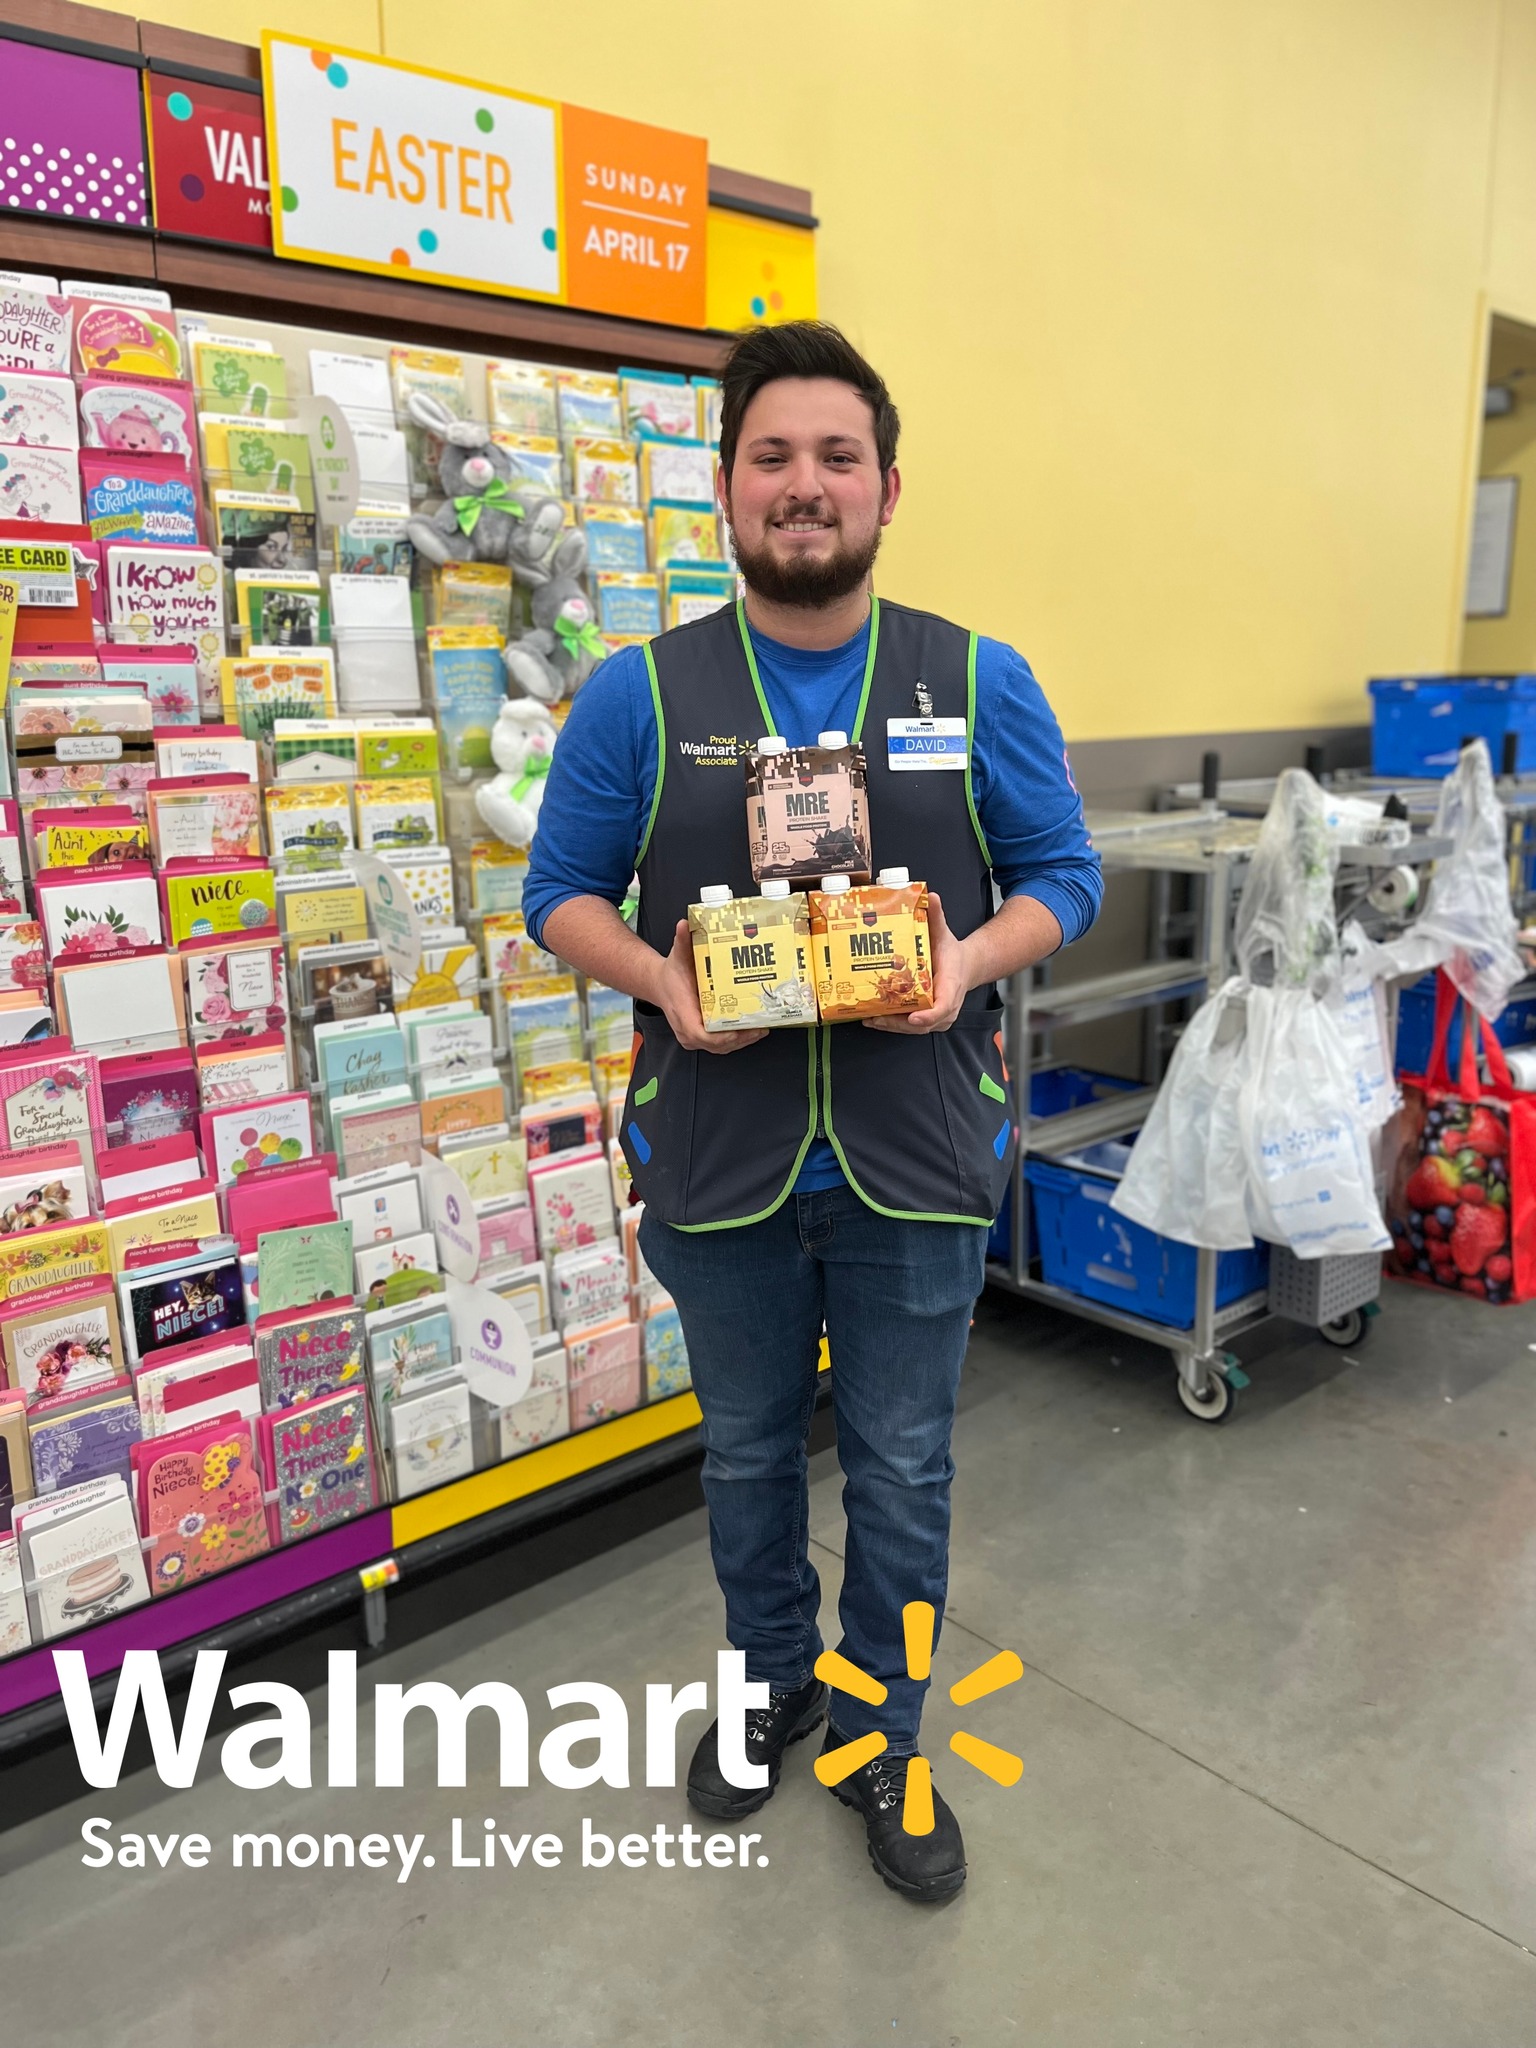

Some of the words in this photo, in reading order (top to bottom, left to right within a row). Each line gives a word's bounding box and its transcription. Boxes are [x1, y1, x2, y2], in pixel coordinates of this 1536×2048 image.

[331, 117, 514, 224] EASTER
[585, 163, 687, 206] SUNDAY
[583, 225, 661, 268] APRIL
[665, 243, 690, 272] 17
[20, 549, 67, 567] CARD
[129, 595, 167, 612] how
[172, 595, 217, 613] much
[153, 614, 210, 637] you're
[709, 734, 737, 746] Proud
[905, 725, 936, 733] Walmart
[680, 741, 737, 756] Walmart
[905, 739, 947, 752] DAVID
[695, 756, 738, 767] Associate
[785, 791, 830, 818] MRE
[788, 816, 811, 824] PROTEIN
[54, 832, 88, 852] Aunt,
[61, 852, 75, 861] this
[214, 856, 240, 864] birthday
[74, 866, 94, 875] niece
[94, 863, 123, 874] birthday
[89, 951, 108, 960] niece
[108, 948, 136, 958] birthday
[850, 931, 894, 957] MRE
[731, 943, 776, 970] MRE
[135, 1055, 153, 1063] niece
[346, 1049, 383, 1074] Chag
[37, 1142, 68, 1154] birthday
[138, 1143, 156, 1152] niece
[138, 1194, 156, 1203] niece
[156, 1186, 184, 1199] birthday
[129, 1249, 148, 1258] niece
[148, 1245, 167, 1255] funny
[167, 1240, 194, 1252] birthday
[10, 1287, 65, 1309] granddaughter
[64, 1280, 94, 1294] birthday
[153, 1300, 185, 1322] HEY,
[156, 1296, 225, 1340] NIECE!
[279, 1330, 352, 1364] Niece
[278, 1358, 345, 1388] There's
[470, 1346, 517, 1378] COMMUNION
[198, 1375, 217, 1384] niece
[37, 1386, 91, 1409] granddaughter
[90, 1377, 119, 1394] birthday
[174, 1428, 195, 1441] niece
[194, 1418, 221, 1434] birthday
[281, 1415, 354, 1457] Niece
[159, 1457, 189, 1473] Happy
[283, 1443, 349, 1480] There's
[321, 1461, 366, 1491] One
[27, 1485, 80, 1510] granddaughter
[79, 1478, 108, 1494] birthday
[152, 1475, 201, 1500] Niece!
[52, 1489, 107, 1516] granddaughter
